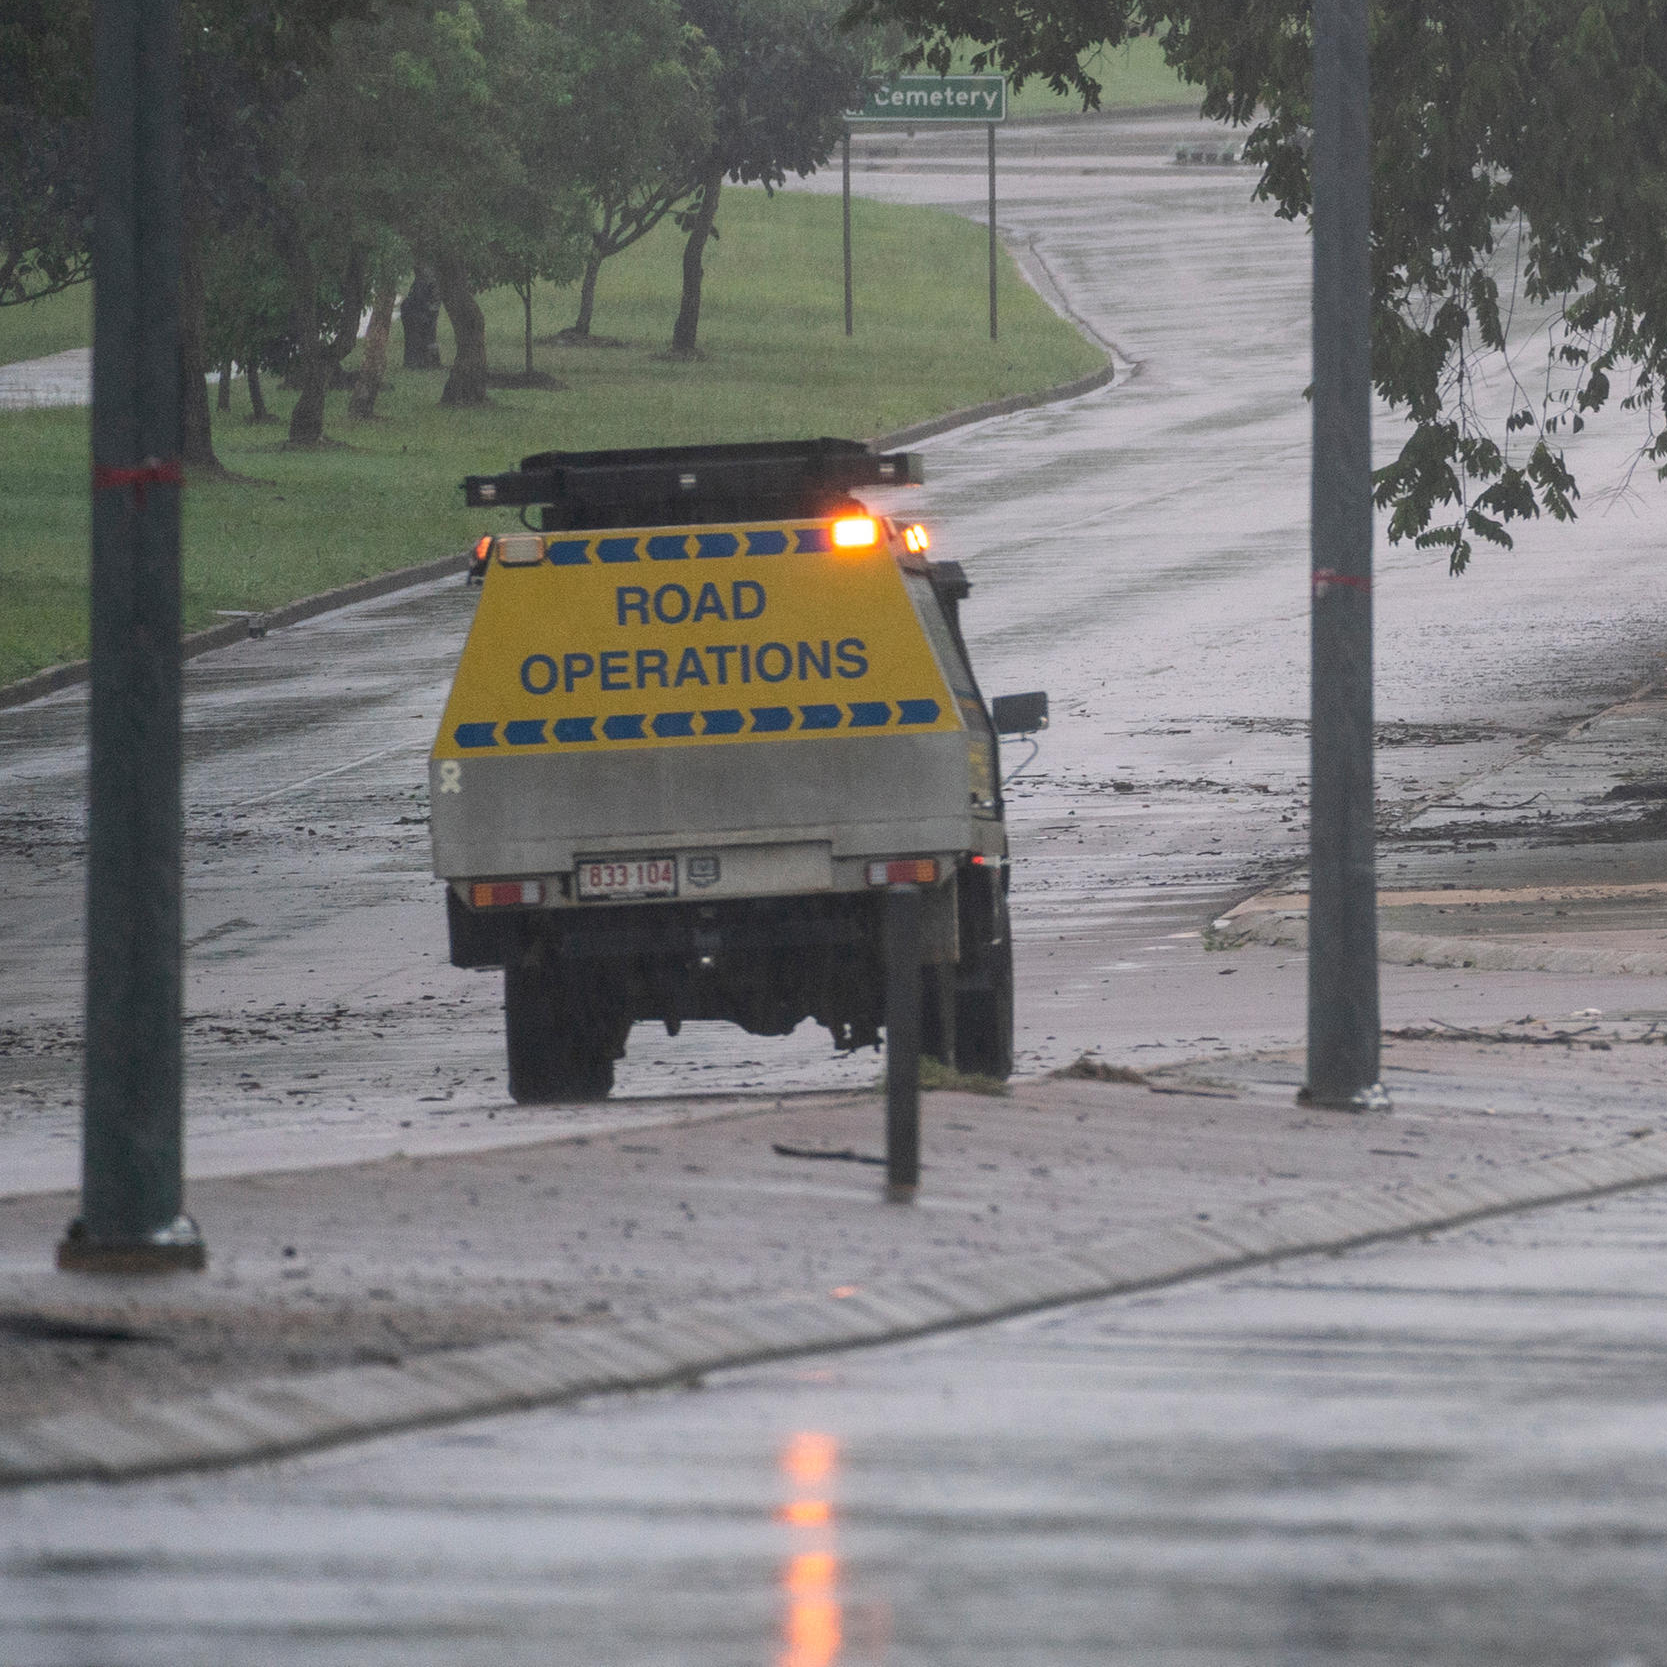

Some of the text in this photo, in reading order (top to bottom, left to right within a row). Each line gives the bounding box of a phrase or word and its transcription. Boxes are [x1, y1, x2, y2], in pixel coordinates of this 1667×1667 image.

[875, 86, 998, 110] Cemetery
[617, 581, 766, 625] ROAD
[520, 638, 868, 694] OPERATIONS
